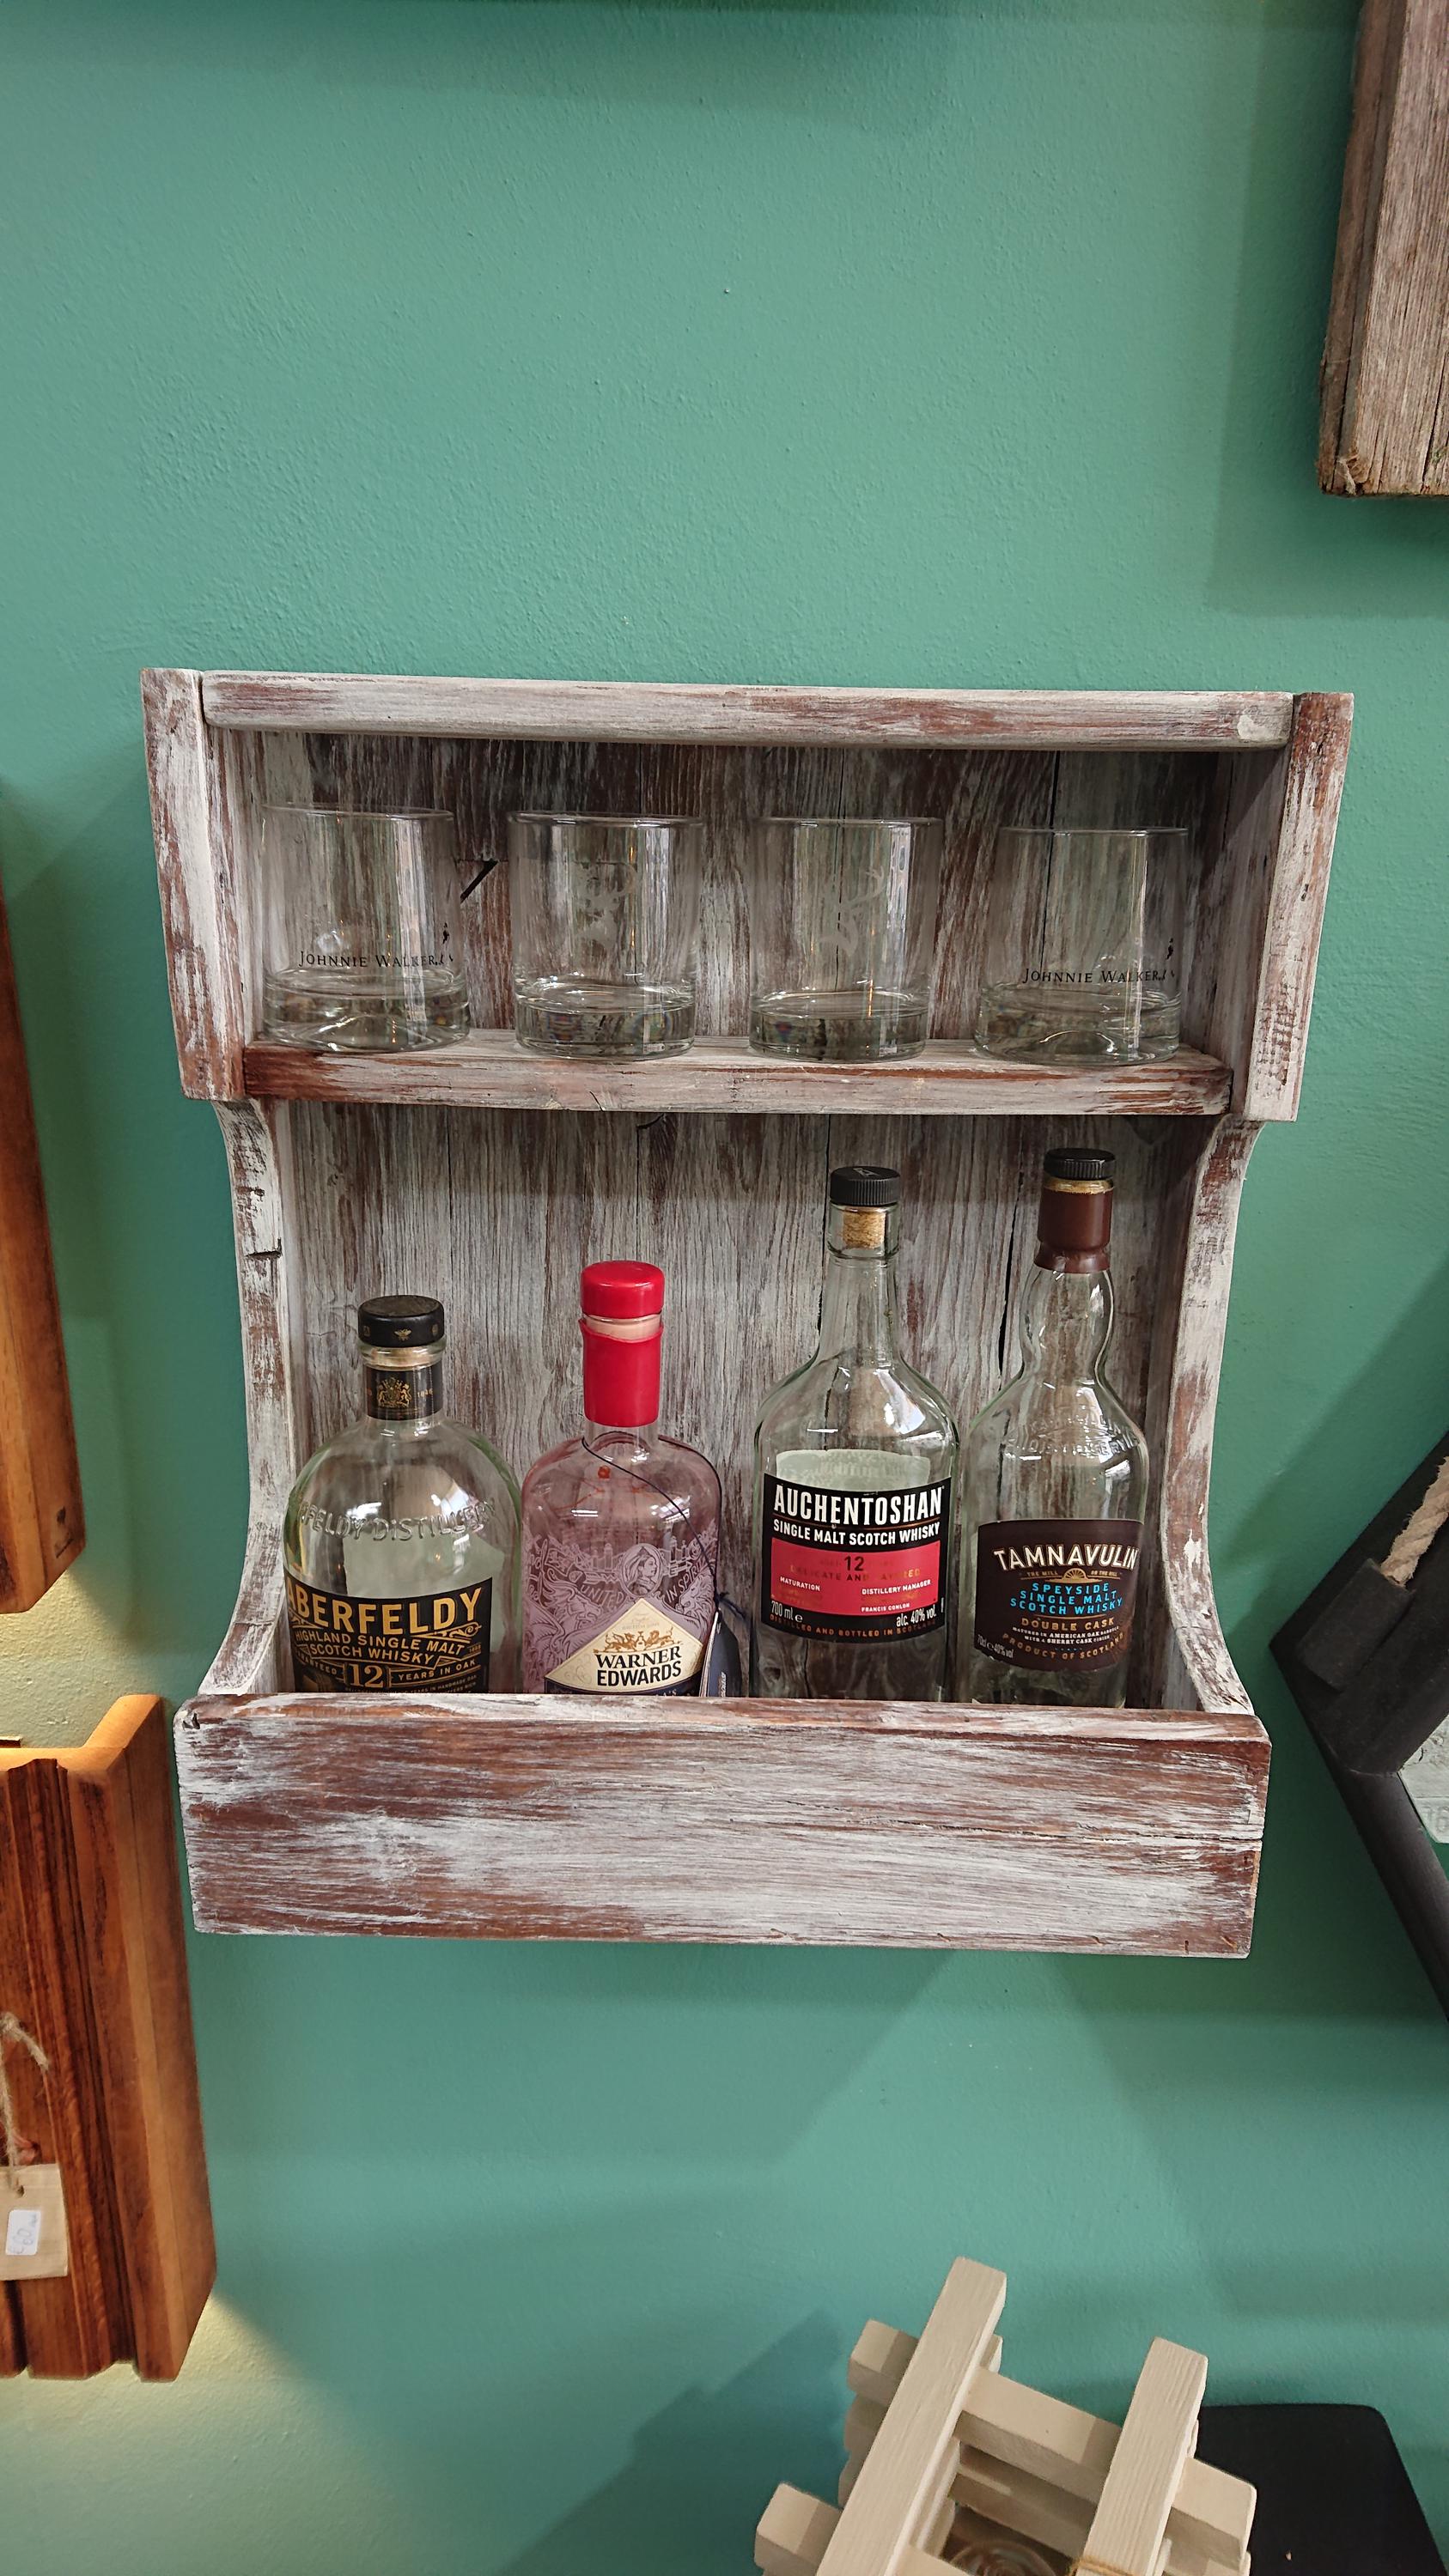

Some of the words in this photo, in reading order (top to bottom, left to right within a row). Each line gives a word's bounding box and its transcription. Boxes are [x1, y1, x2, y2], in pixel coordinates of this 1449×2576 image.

[298, 951, 368, 968] JOHNNIE
[1022, 968, 1093, 984] JOHNNIE
[773, 1484, 942, 1526] AUCHENTOSHAN
[373, 1498, 495, 1540] DISTILLERY
[773, 1518, 811, 1540] SINGLE
[813, 1528, 846, 1545] MALT
[849, 1531, 896, 1546] SCOTCH
[898, 1521, 941, 1543] WHISKY
[844, 1555, 865, 1571] 12
[993, 1544, 1140, 1571] TAMNAVULIN
[780, 1576, 821, 1592] MATURATION
[861, 1585, 901, 1595] DISTILLERY
[902, 1578, 932, 1592] MANAGER
[1032, 1582, 1110, 1595] SPEYSIDE
[580, 1584, 624, 1608] UNITED
[666, 1589, 678, 1603] IN
[1010, 1597, 1067, 1615] SCOTCH
[1074, 1597, 1123, 1615] WHISKY
[1020, 1589, 1076, 1606] SINGLE
[1083, 1589, 1117, 1604] MALT
[285, 1581, 482, 1635] ABERFELDY
[771, 1600, 783, 1617] 700
[784, 1607, 794, 1621] ml
[910, 1608, 926, 1625] 40%
[815, 1626, 835, 1637] AND
[838, 1628, 880, 1637] BOTTLED
[1021, 1617, 1077, 1631] DOUBLE
[1085, 1617, 1115, 1631] CASK
[295, 1629, 351, 1644] HIGHLAND
[357, 1635, 419, 1650] SINGLE
[426, 1640, 465, 1656] MALT
[1002, 1633, 1056, 1659] PRODUCT
[1080, 1632, 1124, 1659] SCOTLAND
[309, 1643, 362, 1658] SCOTCH
[368, 1648, 435, 1665] WHISKY
[594, 1646, 683, 1668] WARNER
[348, 1663, 385, 1689] 12
[398, 1670, 435, 1681] YEARS
[440, 1667, 451, 1676] IN
[456, 1659, 476, 1672] OAK
[597, 1660, 682, 1686] EDWARDS
